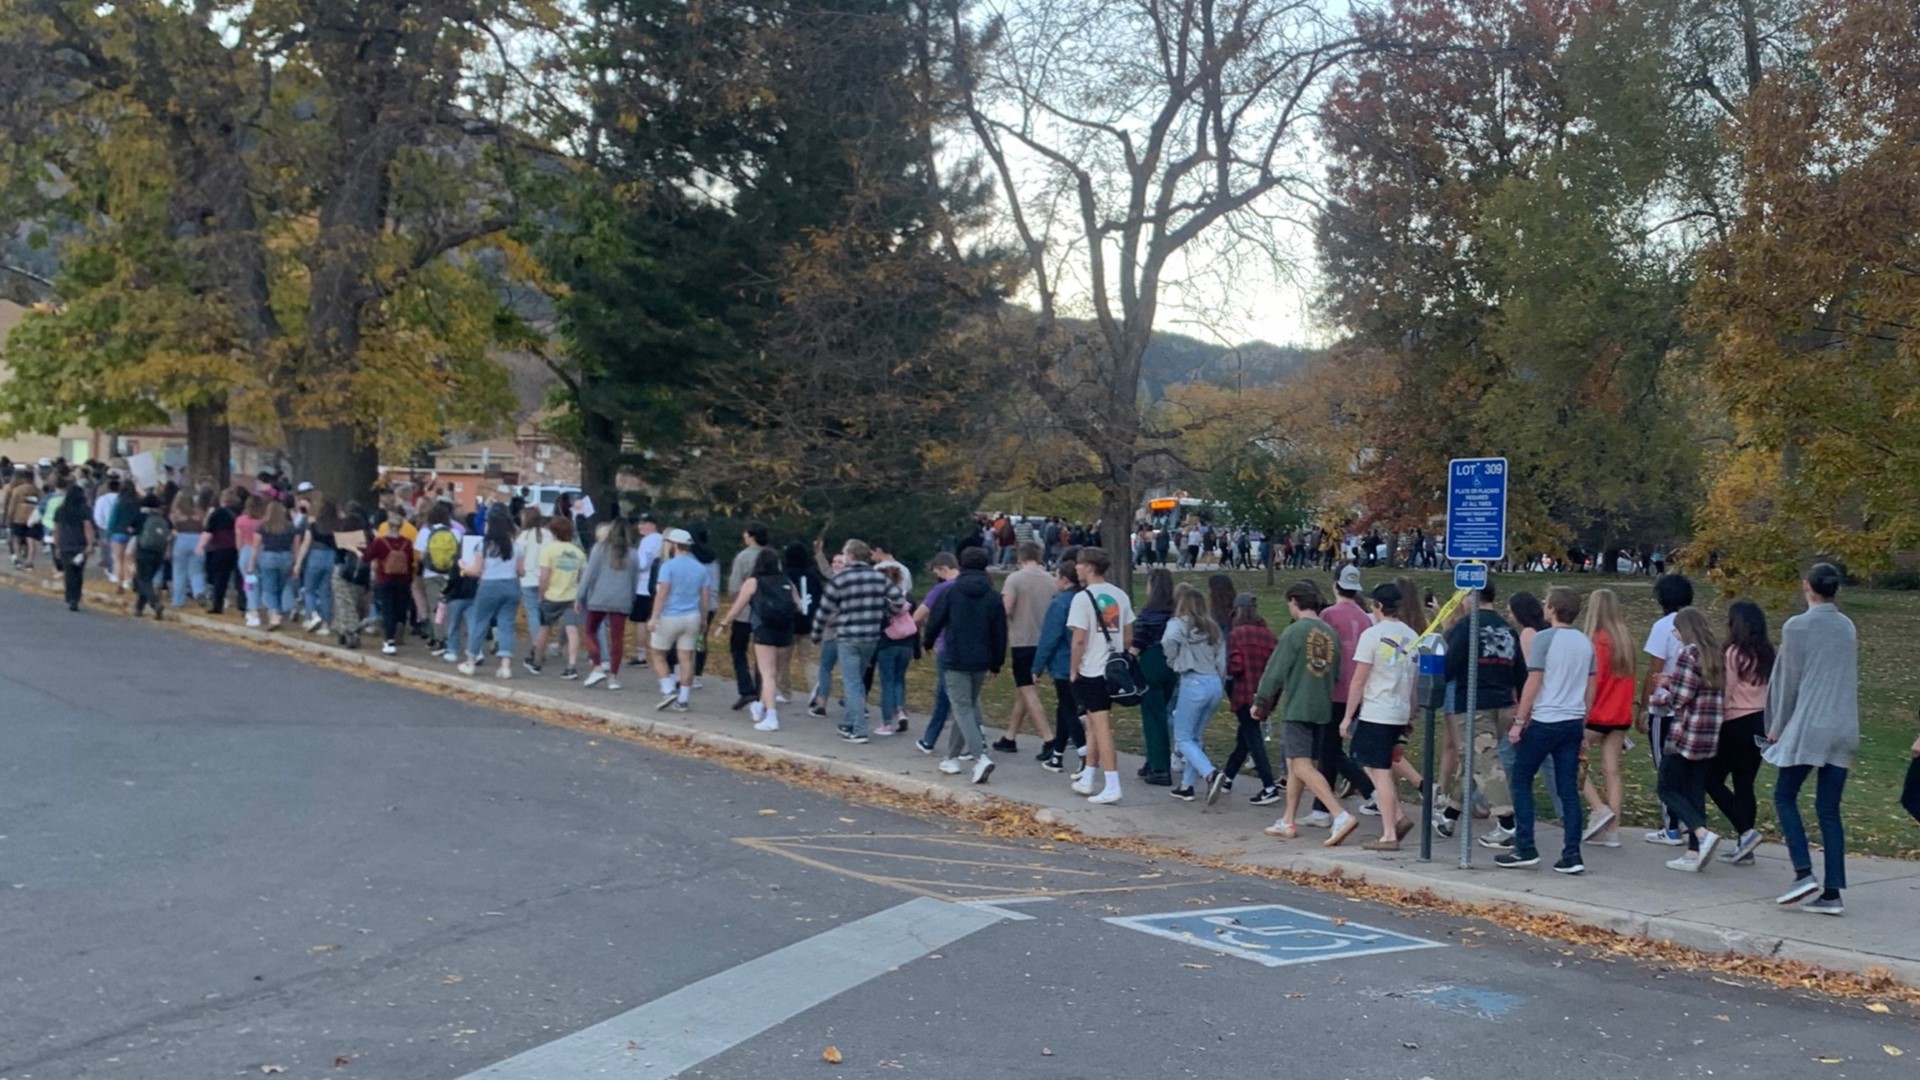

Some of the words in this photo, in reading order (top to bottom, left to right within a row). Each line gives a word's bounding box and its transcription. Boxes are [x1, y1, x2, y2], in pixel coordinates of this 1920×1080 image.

[1456, 464, 1477, 476] LOT
[1484, 463, 1503, 475] 309
[1457, 570, 1470, 581] FINE
